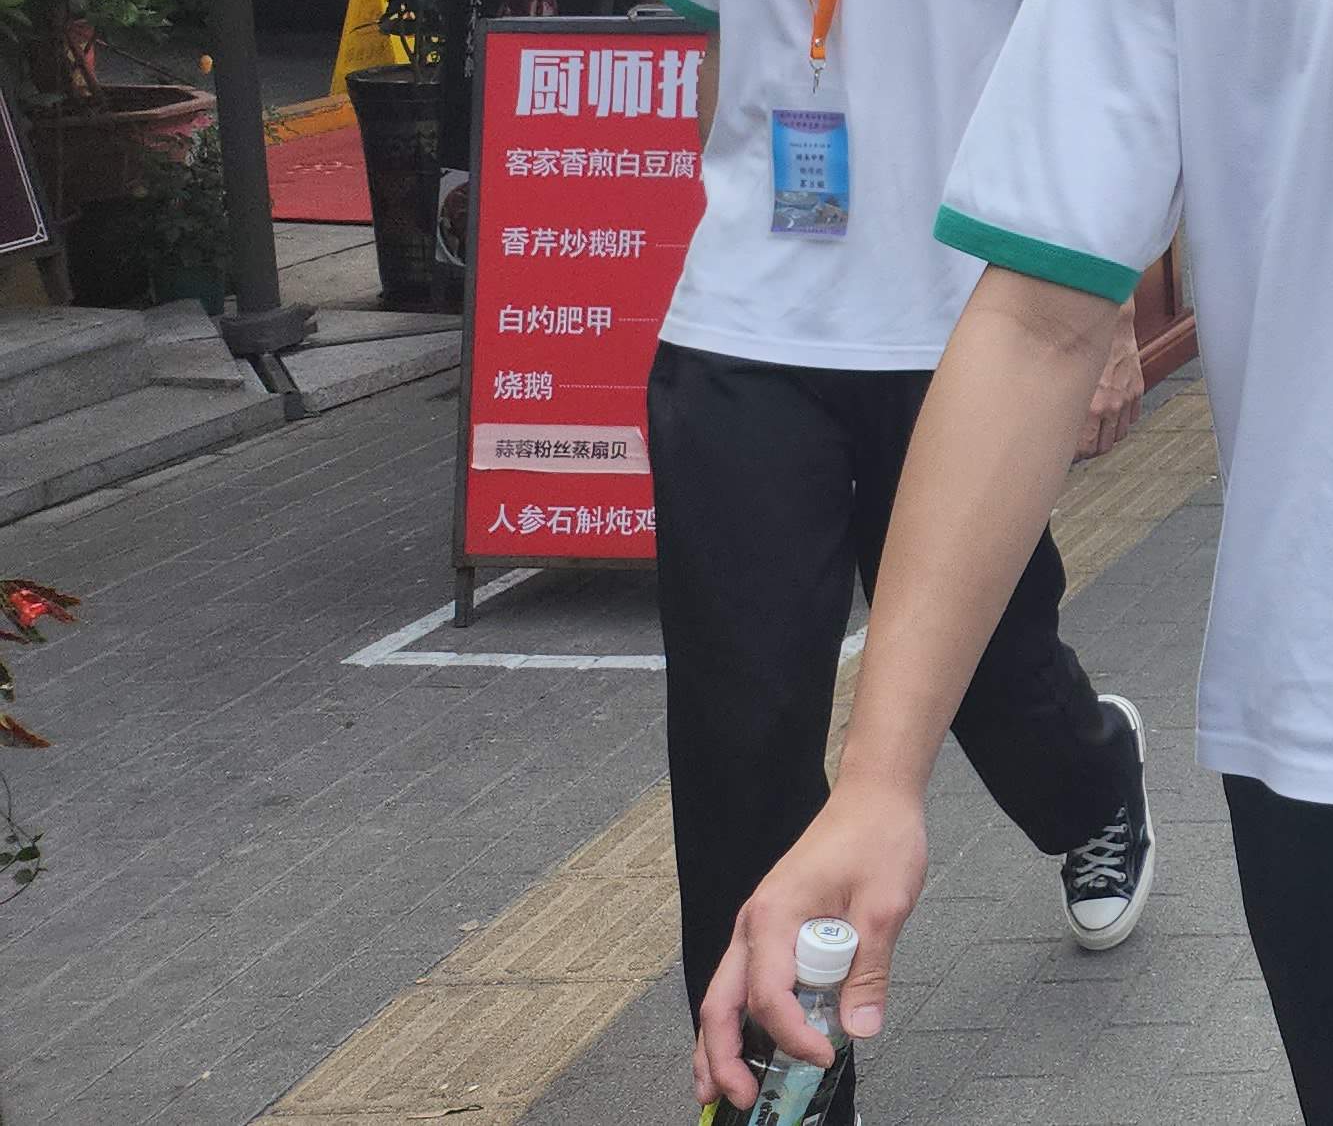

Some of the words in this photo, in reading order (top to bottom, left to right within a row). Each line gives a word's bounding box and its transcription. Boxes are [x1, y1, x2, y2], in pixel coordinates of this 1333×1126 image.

[505, 147, 697, 179] 客家香煎白豆腐
[501, 226, 647, 259] 香芹炒鹅肝
[498, 304, 612, 336] 白灼肥甲
[493, 370, 553, 401] 烧鹅
[495, 438, 628, 461] 蒜蓉粉丝蒸扇贝
[487, 503, 657, 537] 人参石斛炖鸡
